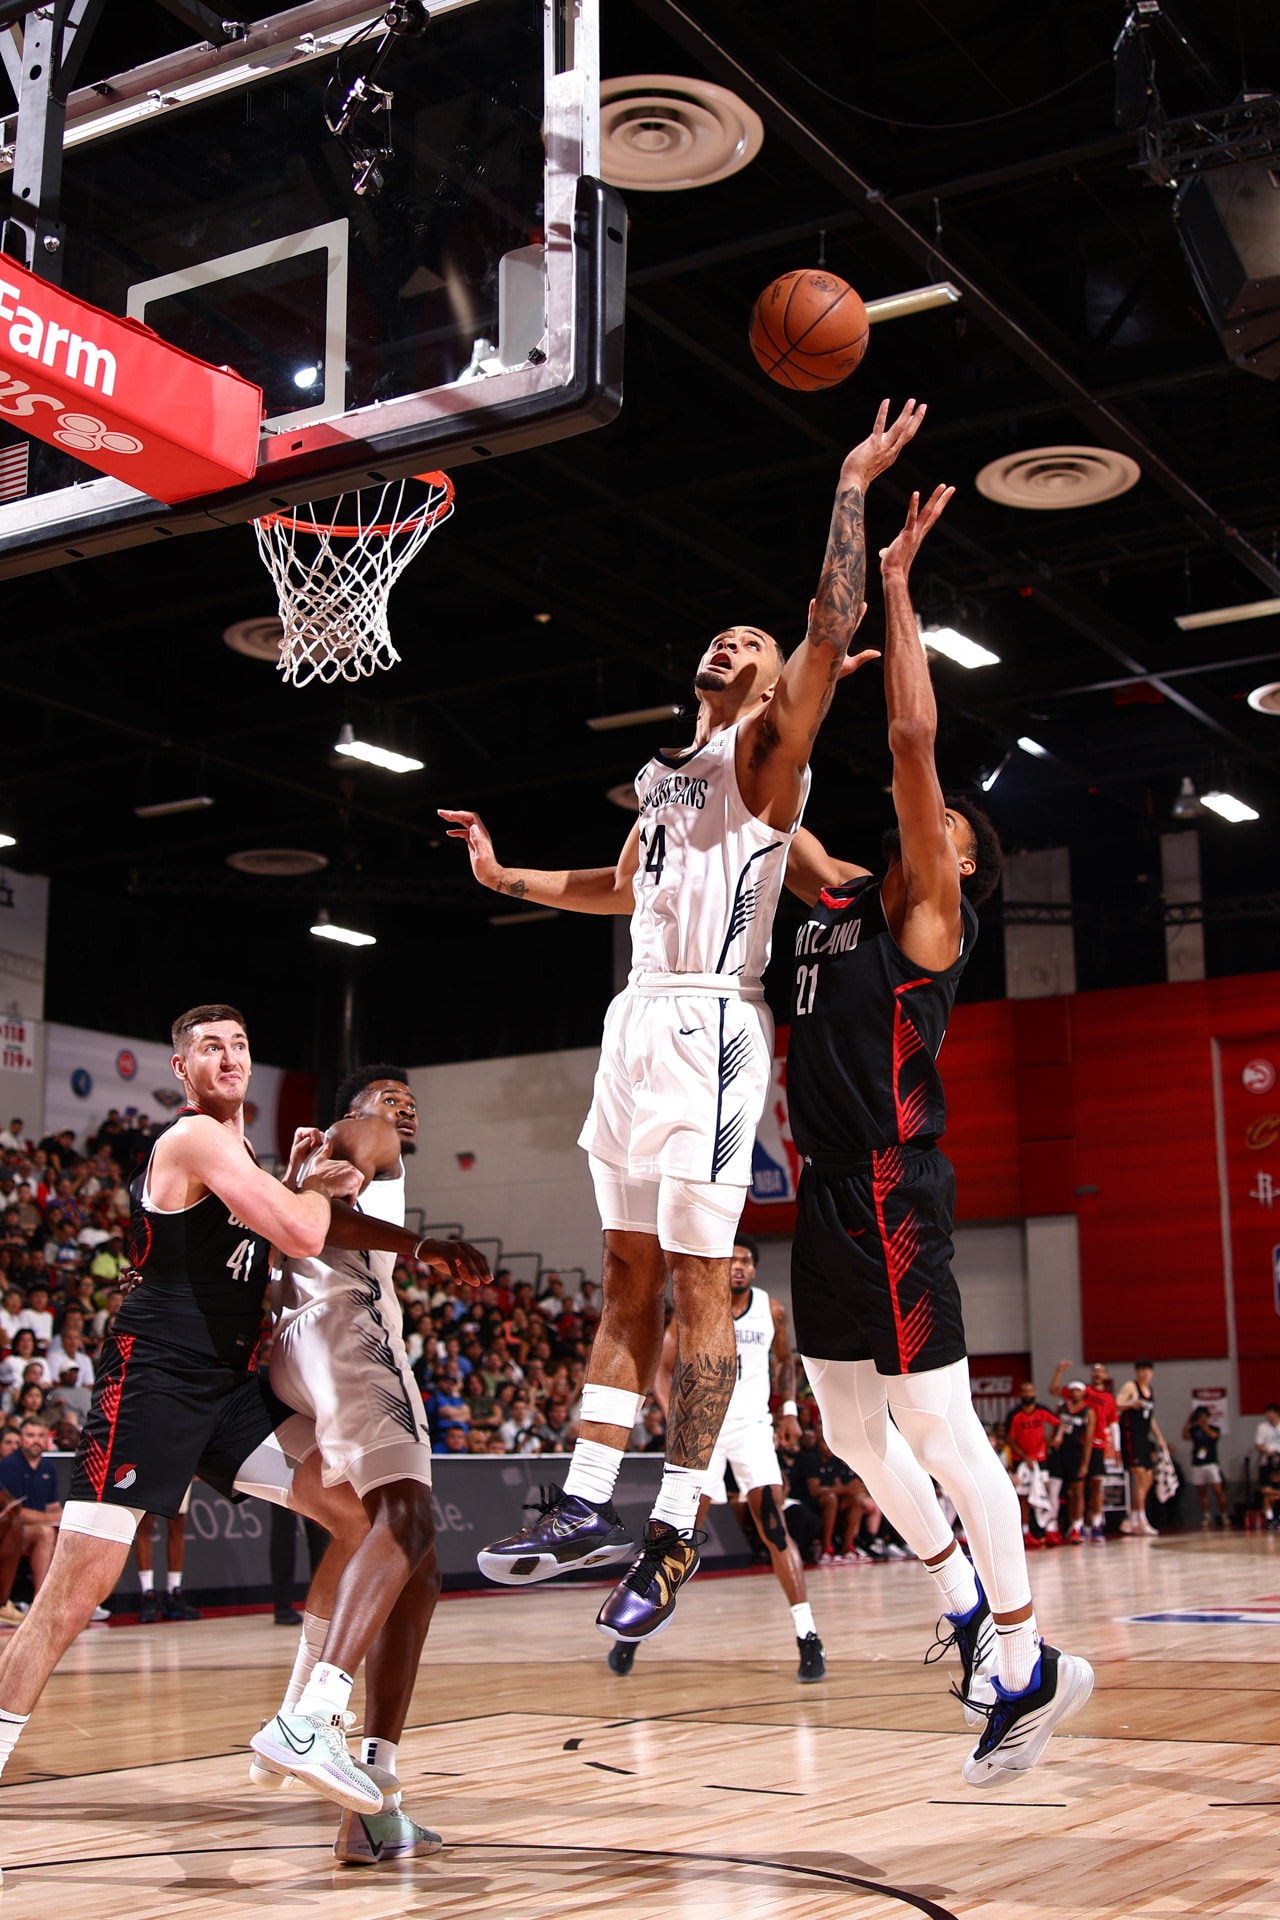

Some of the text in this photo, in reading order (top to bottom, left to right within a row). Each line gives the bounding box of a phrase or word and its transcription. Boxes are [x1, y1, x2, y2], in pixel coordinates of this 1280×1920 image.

[0, 279, 117, 397] Farm
[796, 963, 819, 1016] 21
[226, 1238, 256, 1282] 41
[184, 1498, 264, 1541] 025
